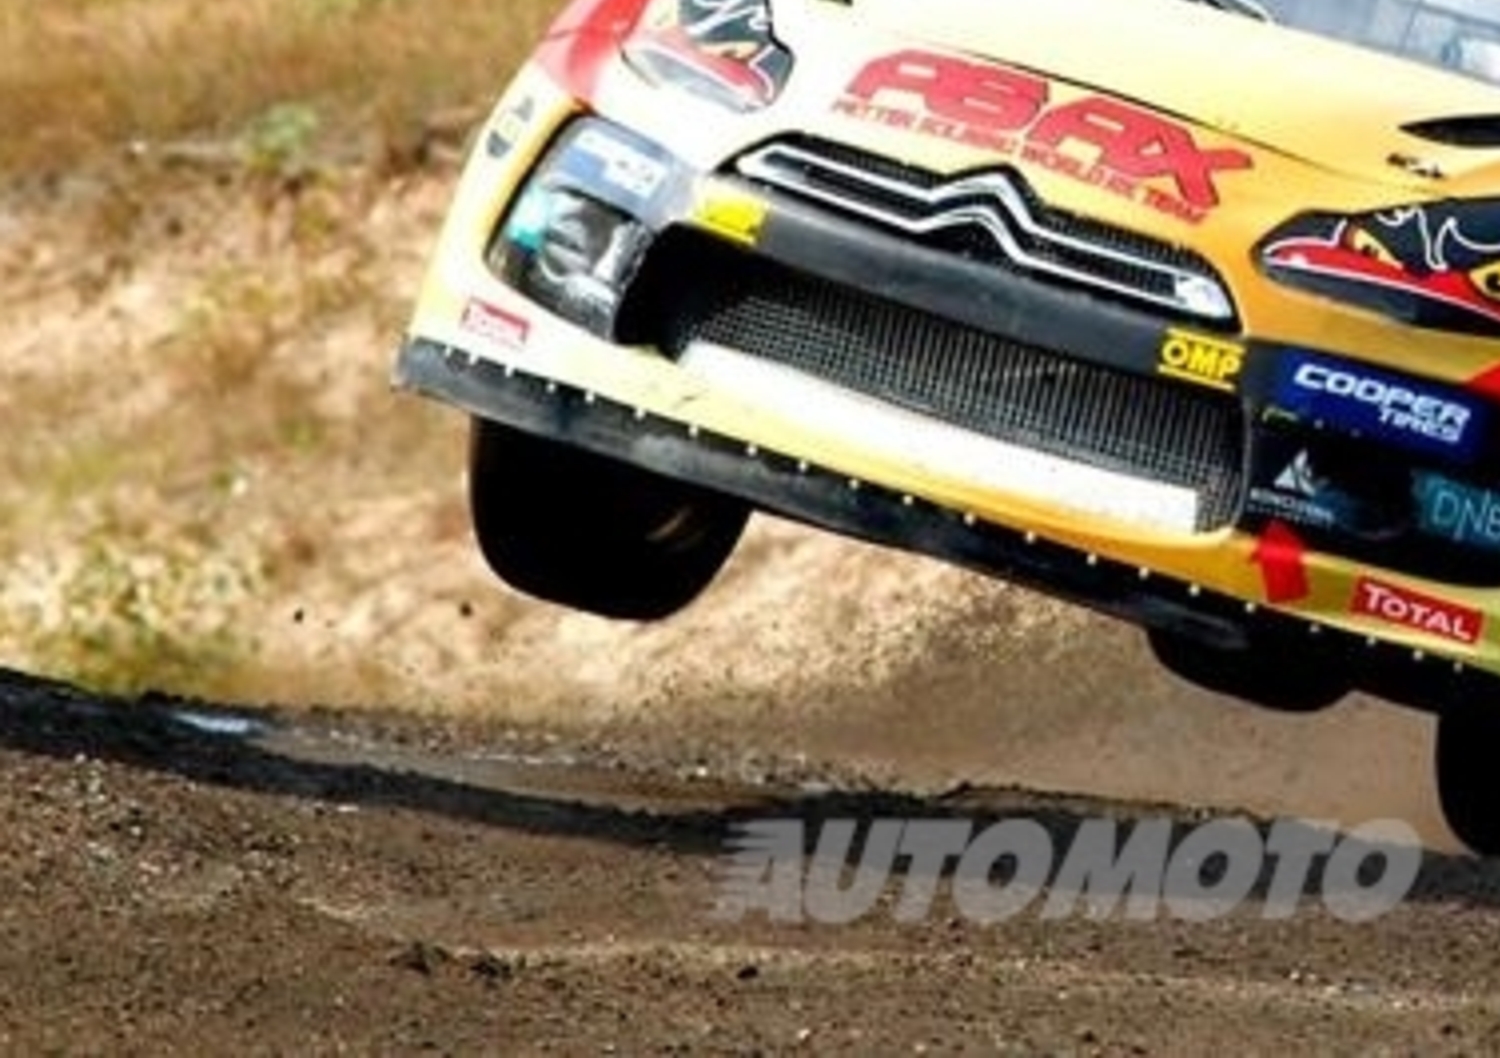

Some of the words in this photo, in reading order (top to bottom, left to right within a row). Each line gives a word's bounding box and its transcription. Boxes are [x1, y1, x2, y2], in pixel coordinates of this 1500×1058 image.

[1160, 338, 1241, 380] OMP
[1294, 362, 1472, 429] COOPER
[1363, 582, 1473, 642] TOTAL
